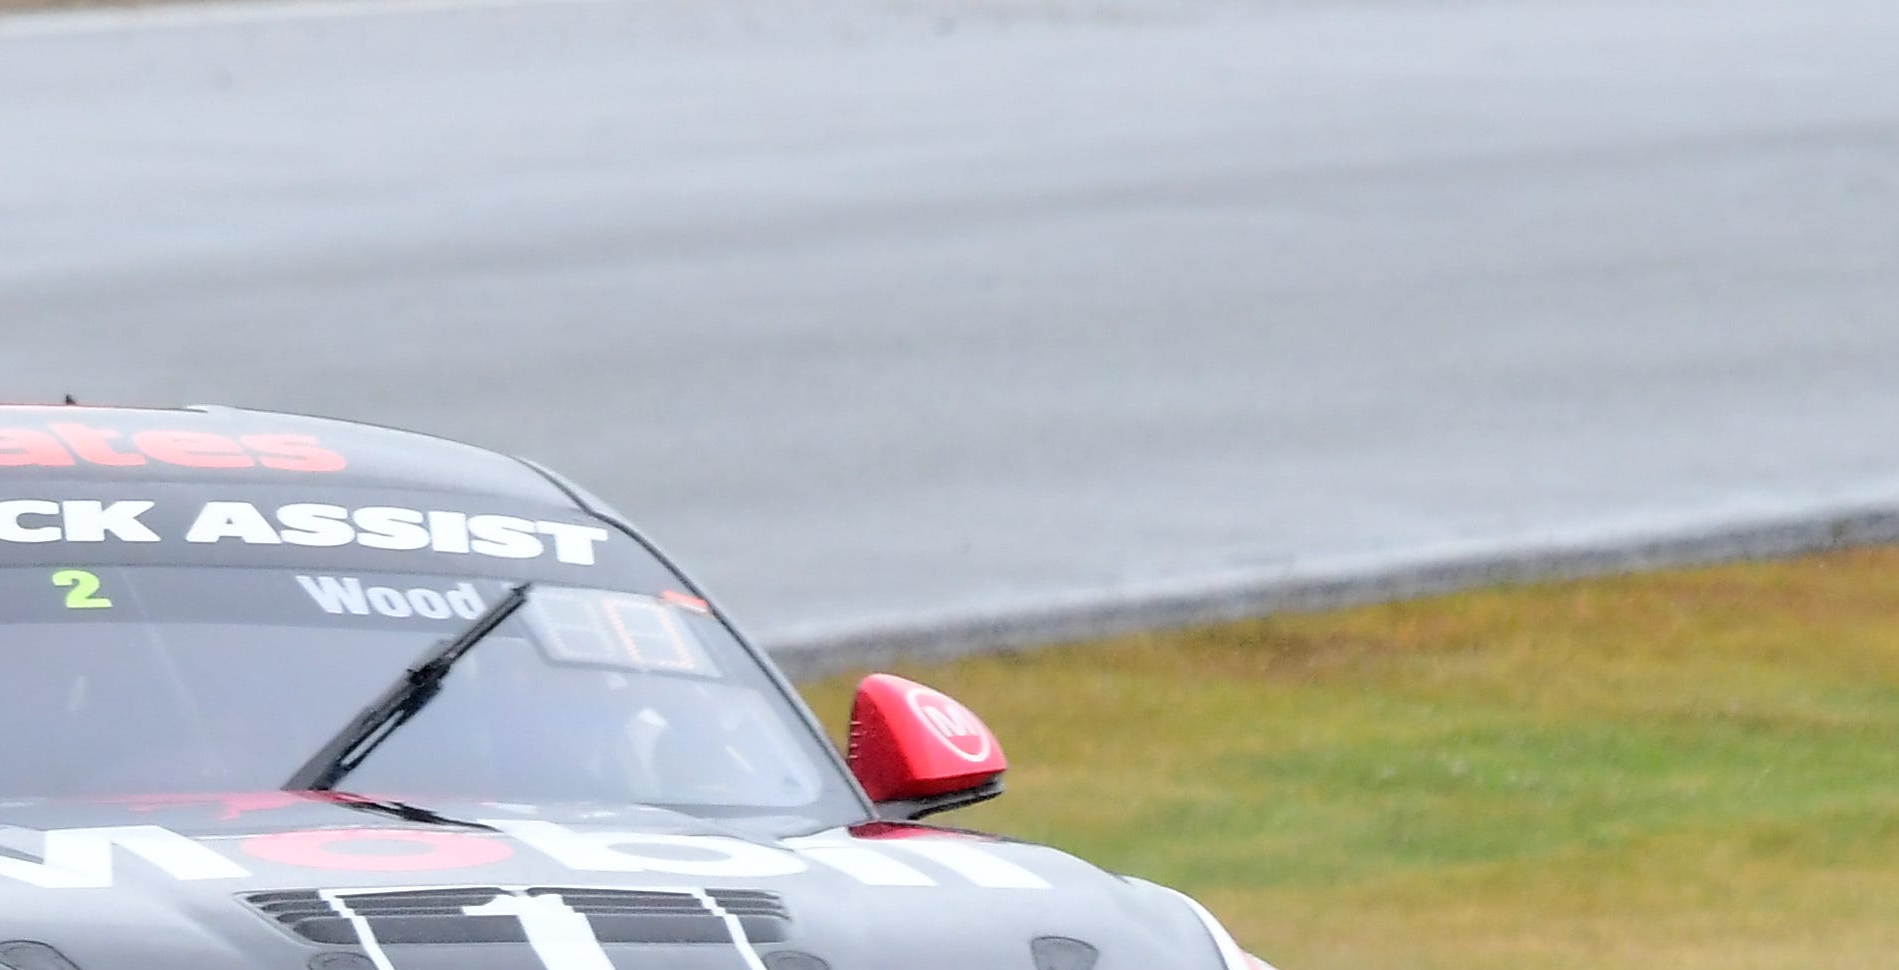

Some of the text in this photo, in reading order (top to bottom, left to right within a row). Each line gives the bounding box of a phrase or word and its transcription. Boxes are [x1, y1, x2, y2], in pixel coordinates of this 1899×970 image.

[186, 501, 609, 566] ASSIST
[52, 569, 112, 609] 2
[297, 574, 489, 621] Wood
